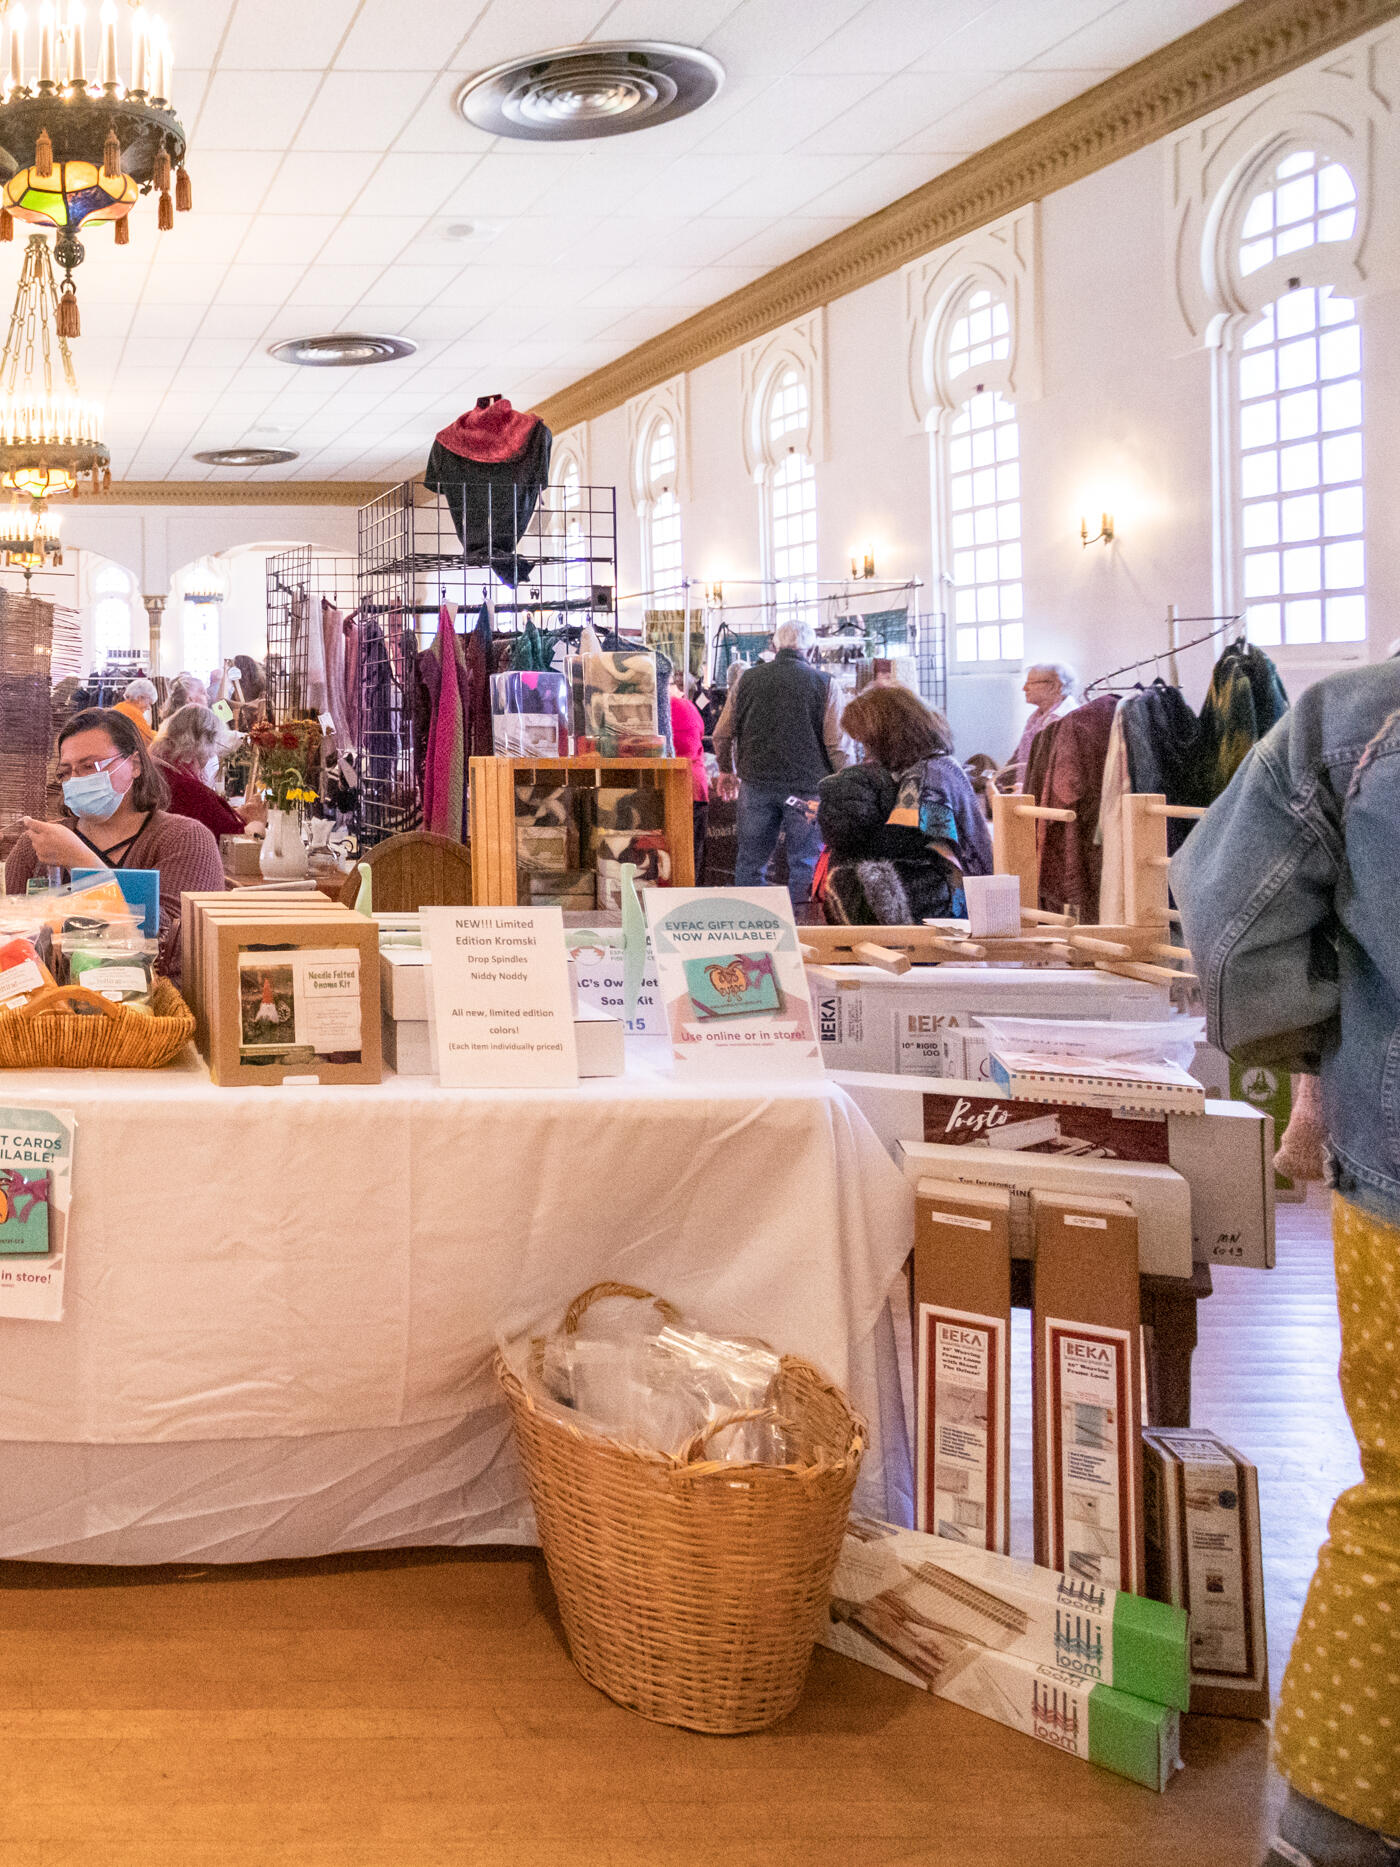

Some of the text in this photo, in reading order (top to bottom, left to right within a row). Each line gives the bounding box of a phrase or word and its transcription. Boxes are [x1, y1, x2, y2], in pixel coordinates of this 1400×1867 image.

[455, 919, 534, 929] NEW!!! Limited
[665, 920, 780, 931] EVFAC GIFT CARDS
[456, 936, 537, 946] Edition Kromski
[672, 931, 777, 942] NOW AVAILABLE!
[467, 955, 528, 965] Drop Spindles
[308, 970, 356, 980] Needle Felted
[471, 972, 528, 981] Niddy Noddy
[452, 1009, 554, 1018] All new, limited edition
[821, 999, 836, 1042] BEKA
[907, 1014, 959, 1033] BEKA
[489, 1026, 519, 1034] colors!
[681, 1030, 806, 1042] Use online or in store!
[448, 1043, 563, 1051] (Each item individually priced)
[944, 1097, 1013, 1133] Presto
[13, 1136, 62, 1151] CARDS
[1, 1269, 13, 1281] in
[16, 1272, 52, 1285] store!
[941, 1327, 982, 1347] BEKA
[1066, 1342, 1110, 1362] BEKA
[1056, 1650, 1102, 1679] loom
[1034, 1719, 1078, 1754] loom
